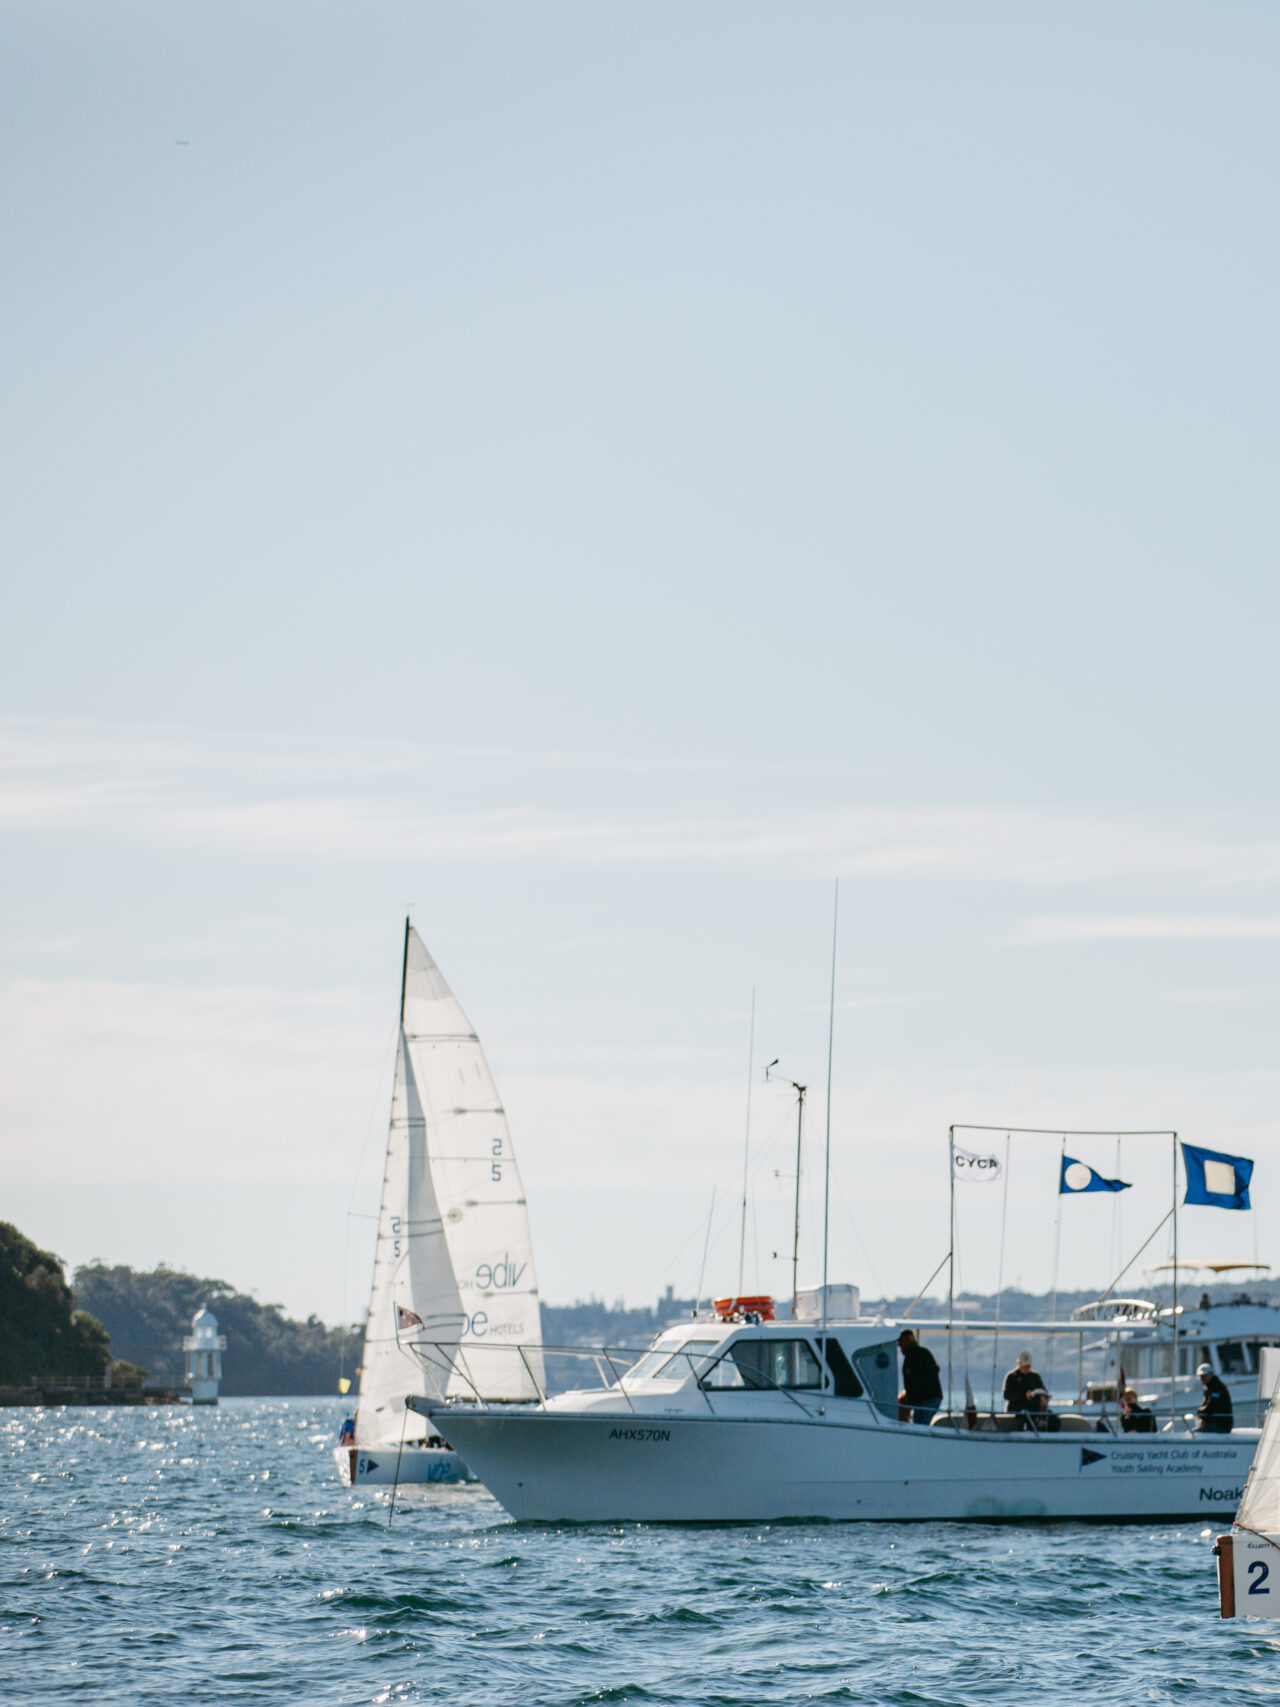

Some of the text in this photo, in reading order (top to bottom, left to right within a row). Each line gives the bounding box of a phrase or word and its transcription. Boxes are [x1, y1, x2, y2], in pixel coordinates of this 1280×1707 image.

[955, 1155, 998, 1168] CYCA
[491, 1164, 502, 1182] 5
[608, 1428, 671, 1441] AHX570N
[1111, 1450, 1237, 1461] Cruising Yacht Club of Australia
[1111, 1463, 1203, 1474] Youth Sailing Academy
[1199, 1487, 1244, 1501] Noak
[1247, 1560, 1270, 1594] 2
